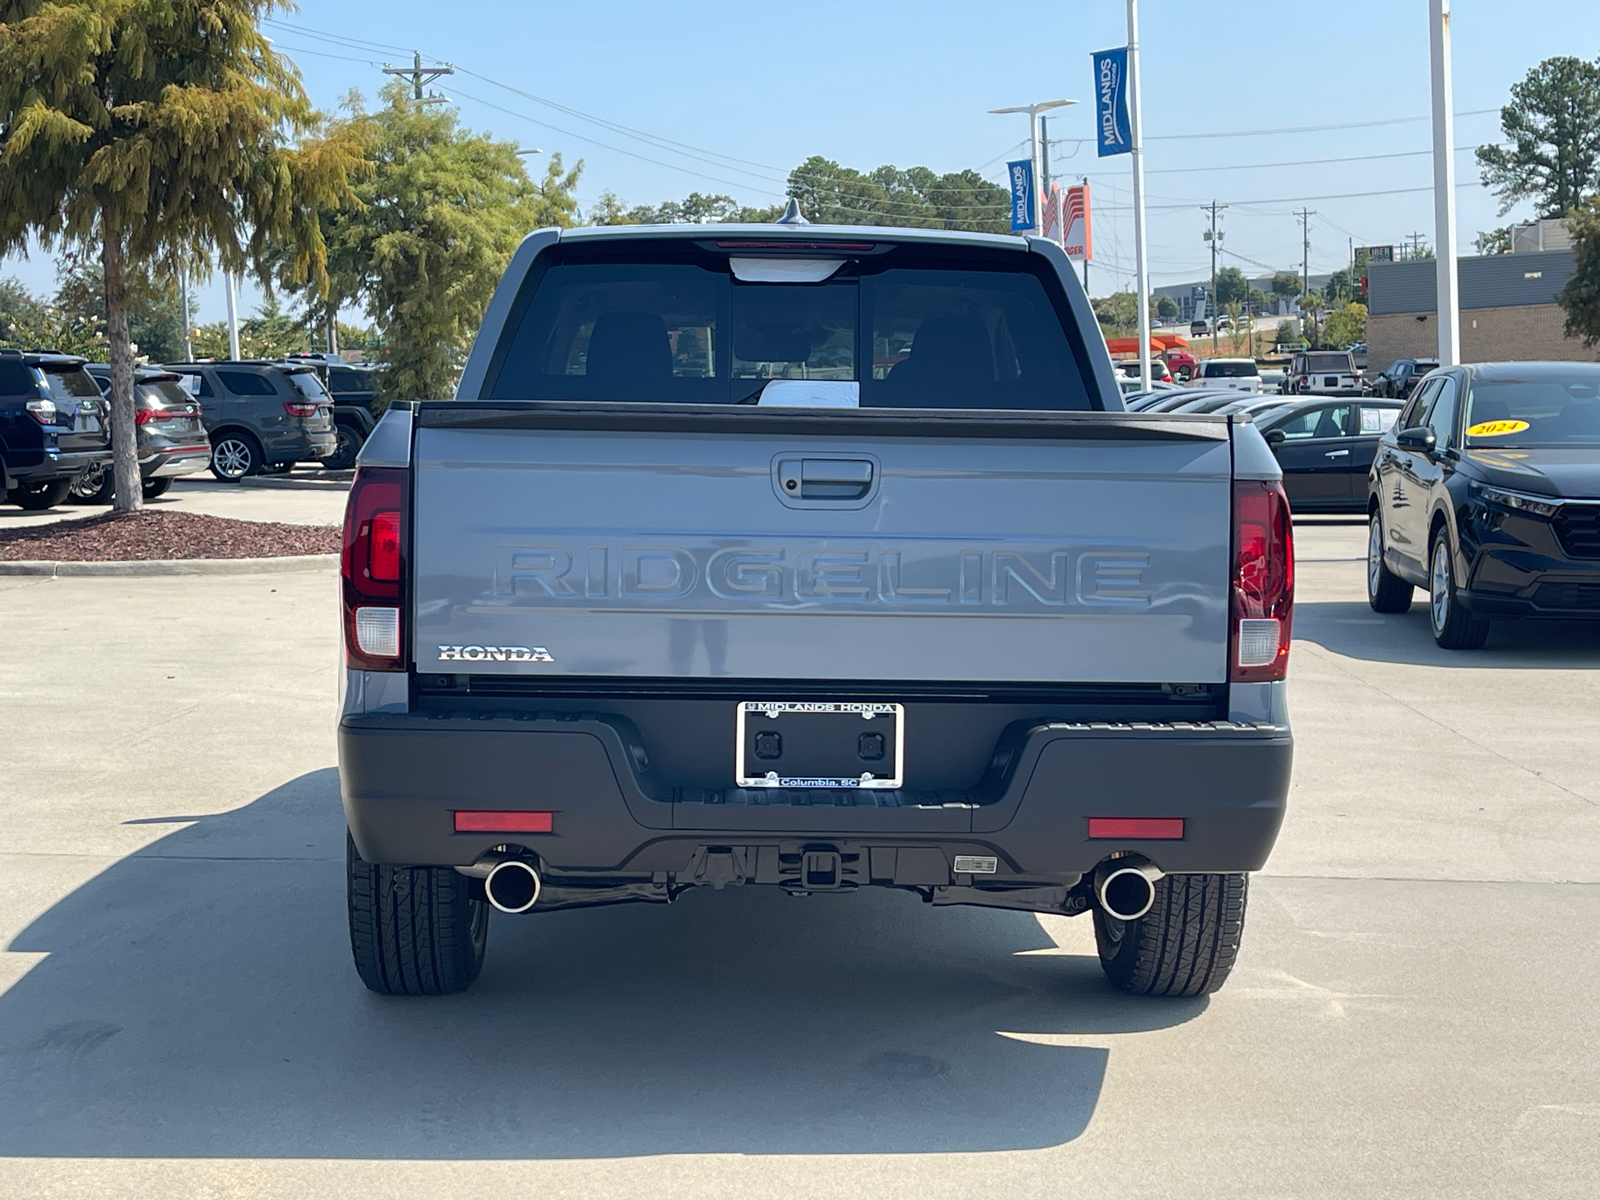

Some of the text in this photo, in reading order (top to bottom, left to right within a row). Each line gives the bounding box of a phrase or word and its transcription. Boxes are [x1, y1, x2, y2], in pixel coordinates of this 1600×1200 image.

[1100, 58, 1116, 146] MIDLANDS
[1012, 165, 1025, 225] MIDLANDS
[1475, 422, 1519, 435] 2024
[493, 542, 1152, 607] RIDGELINE
[437, 645, 555, 662] HONDA
[757, 702, 895, 712] MIDLANDS HONDA
[841, 779, 859, 787] SC
